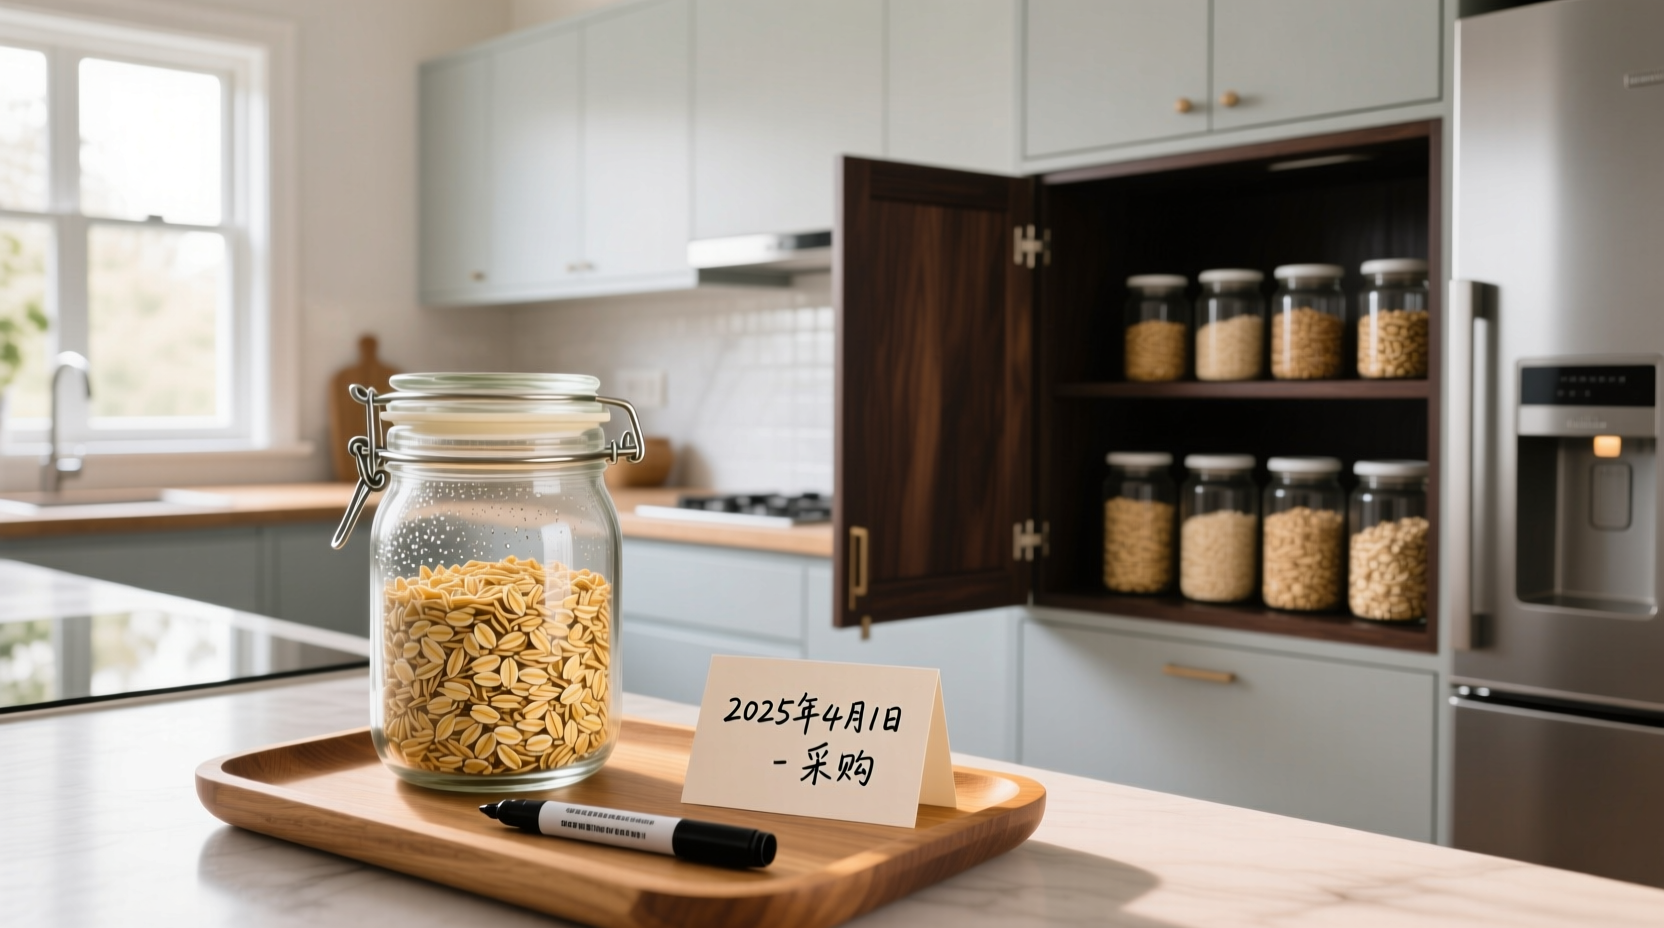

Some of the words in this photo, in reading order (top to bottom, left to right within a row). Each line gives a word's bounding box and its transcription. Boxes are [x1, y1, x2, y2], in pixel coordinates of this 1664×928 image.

[722, 691, 902, 735] 2025年4月1日
[800, 742, 875, 787] 采购
